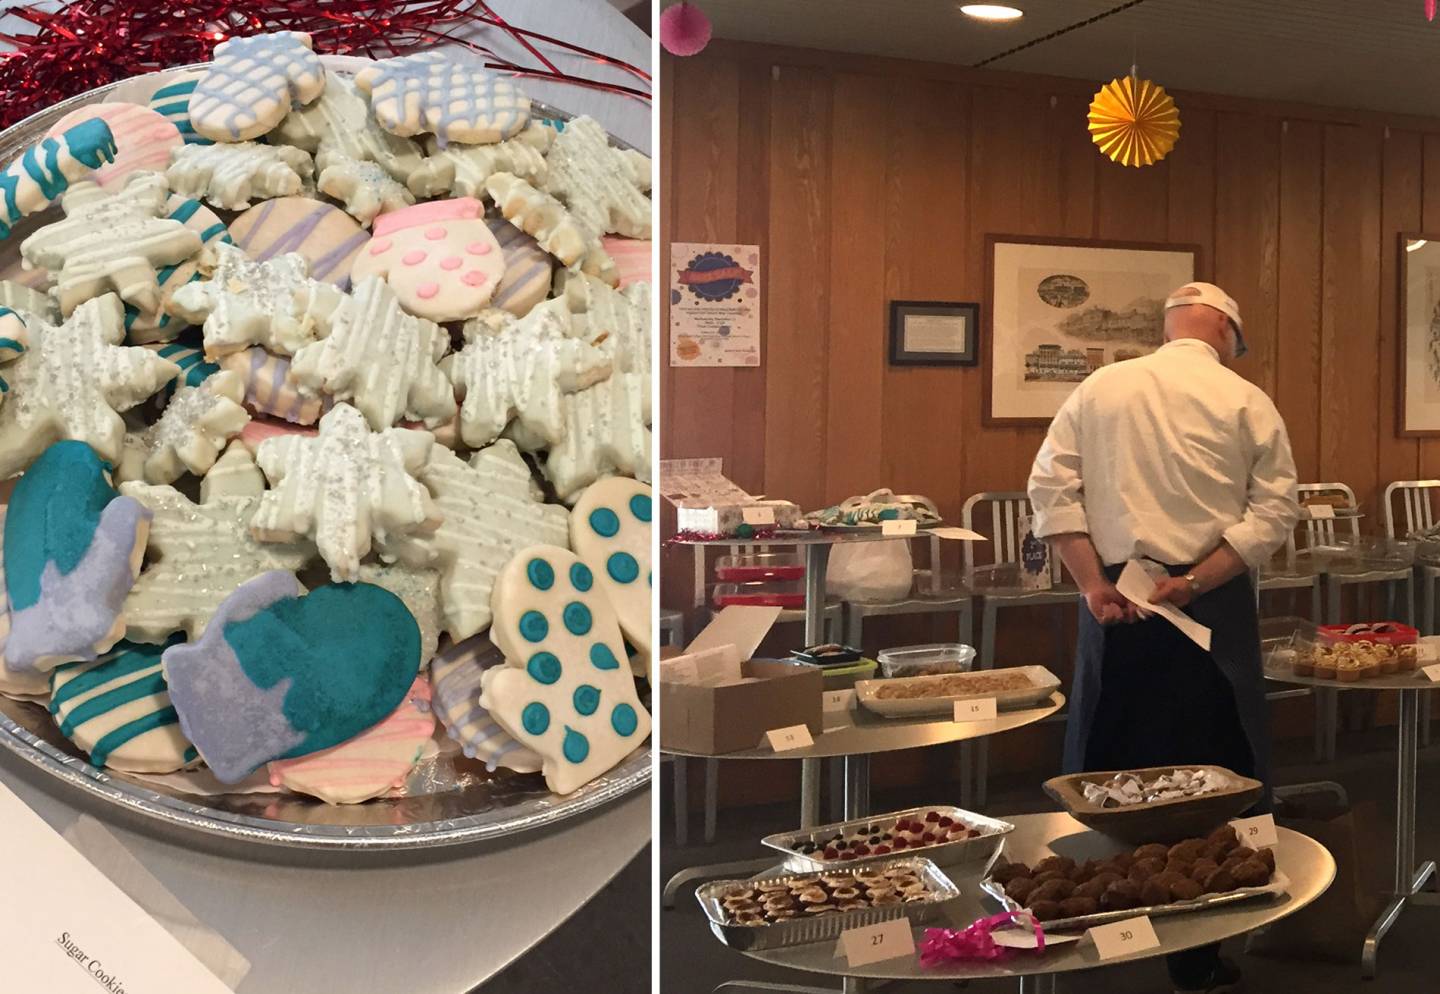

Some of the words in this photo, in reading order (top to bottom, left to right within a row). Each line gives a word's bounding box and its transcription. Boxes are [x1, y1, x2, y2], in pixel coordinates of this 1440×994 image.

[1248, 826, 1259, 836] 29
[872, 933, 884, 946] 27
[1120, 930, 1134, 941] 30
[57, 931, 89, 963] Sugar
[87, 959, 127, 994] Cookie
